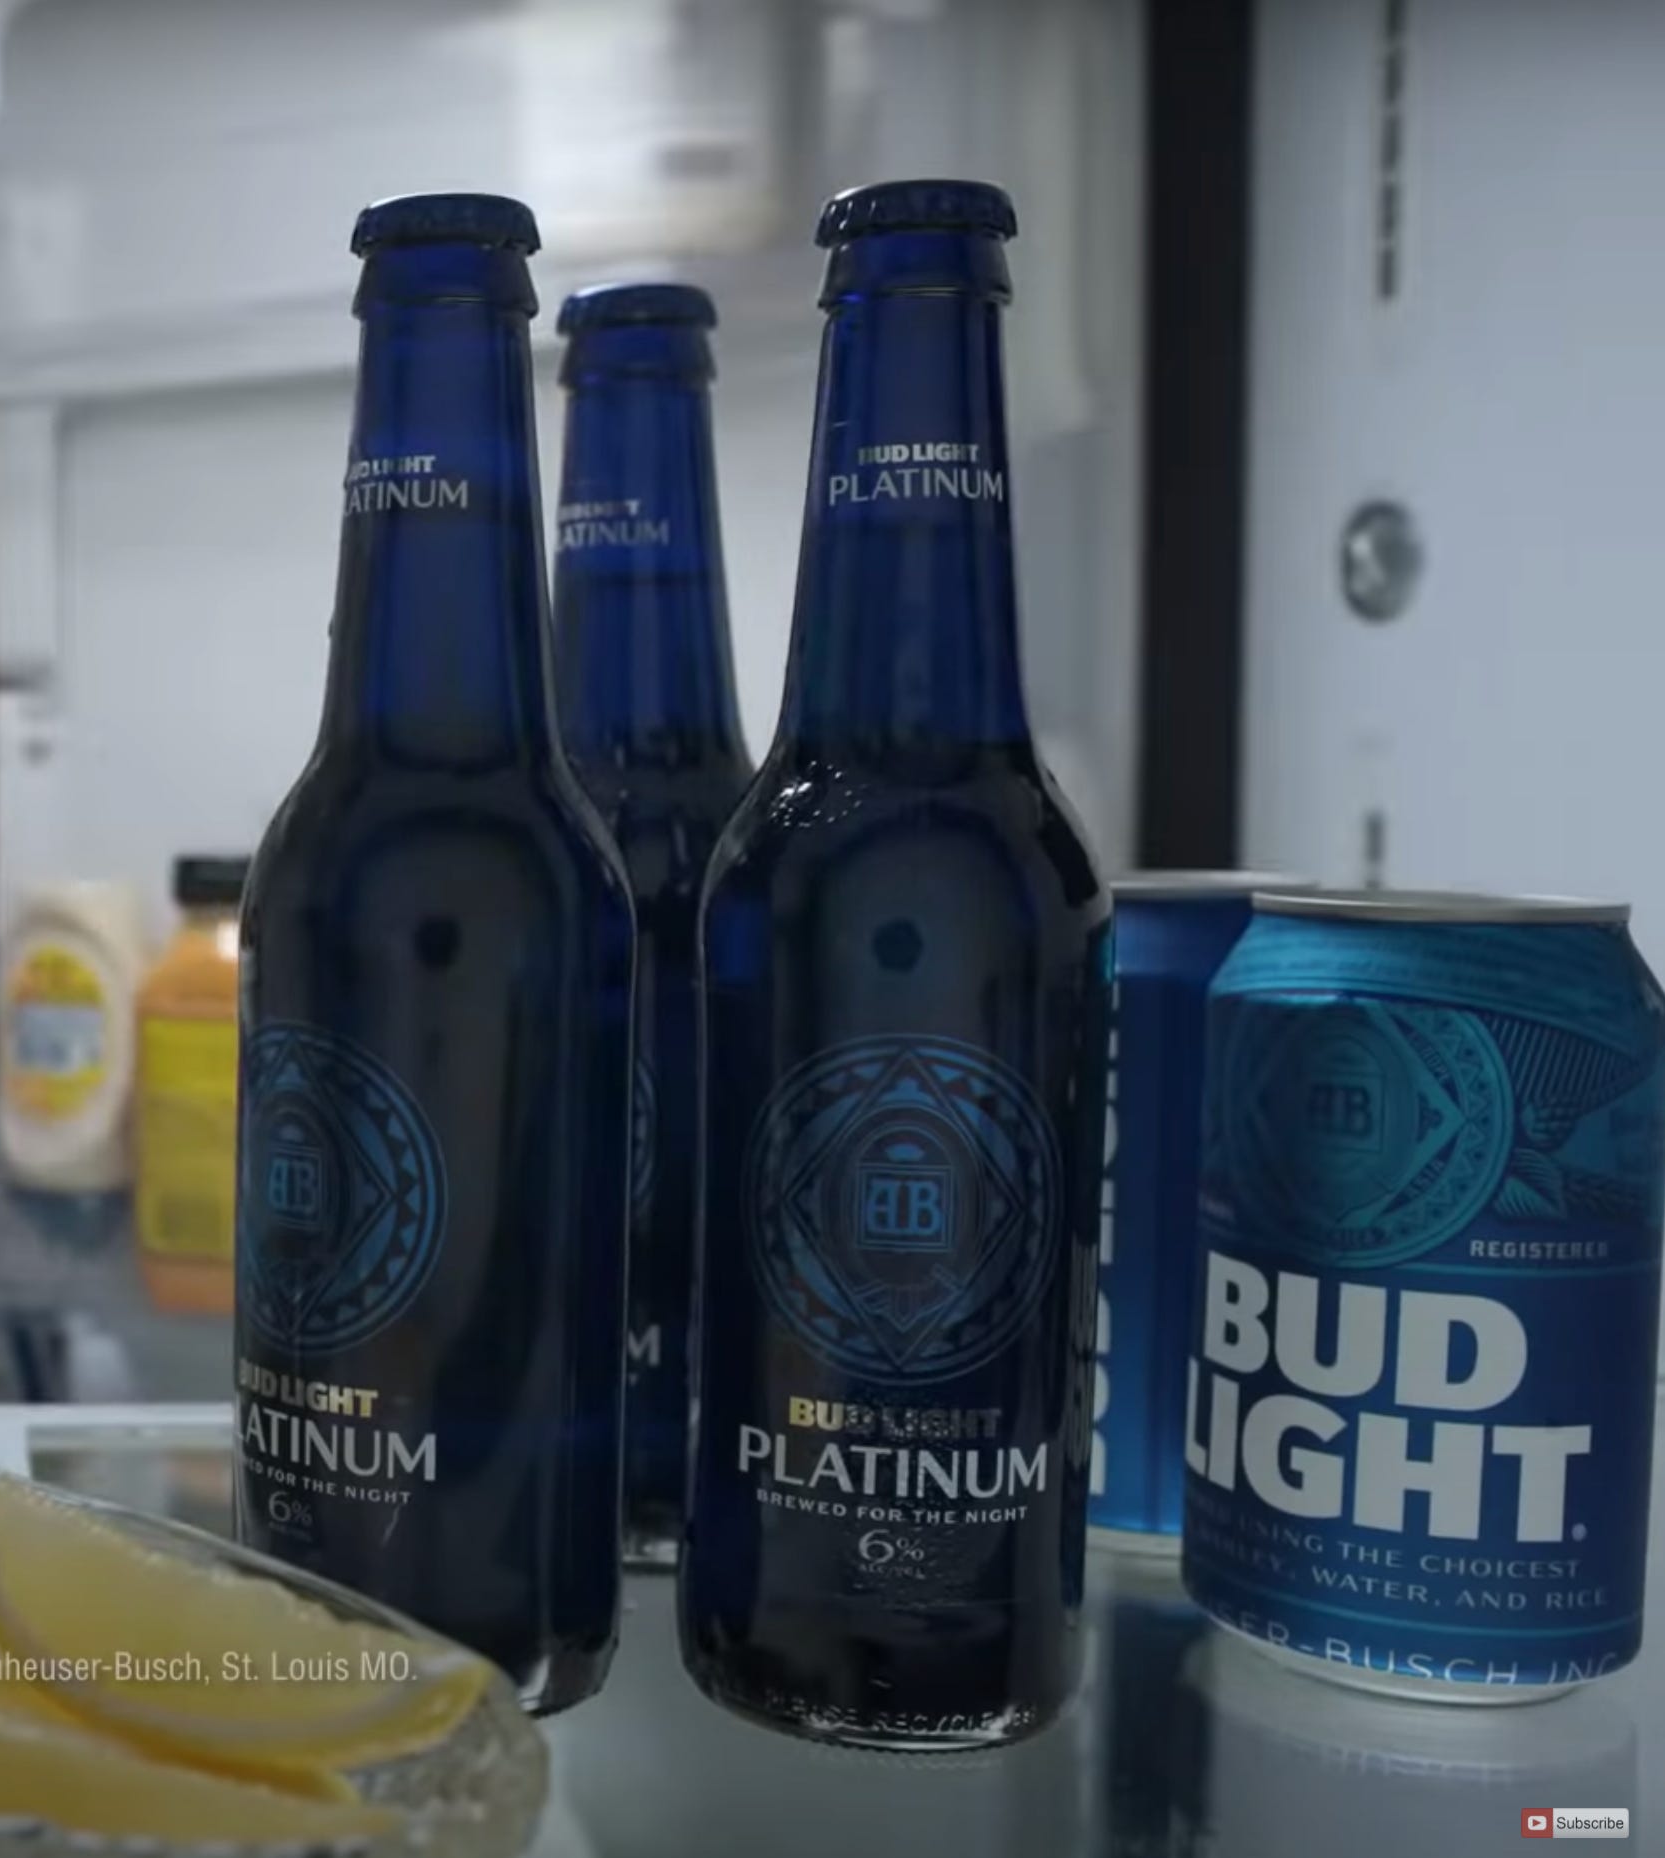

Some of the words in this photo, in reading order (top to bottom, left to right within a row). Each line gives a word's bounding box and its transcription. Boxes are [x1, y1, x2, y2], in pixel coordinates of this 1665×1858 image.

[858, 444, 910, 465] BUD
[912, 442, 980, 463] LIGHT
[343, 478, 469, 516] ATINUM
[829, 466, 1004, 507] PLATINUM
[556, 517, 670, 553] ATINUM
[1203, 1249, 1528, 1412] BUD
[280, 1374, 379, 1418] LIGHT
[788, 1396, 877, 1435] BUD
[882, 1407, 1002, 1439] LIGHT
[237, 1402, 437, 1481] ATINUM
[738, 1423, 1049, 1500] PLATINUM
[1184, 1357, 1593, 1543] LIGHT
[267, 1465, 296, 1487] FOR
[302, 1477, 338, 1496] THE
[345, 1485, 411, 1504] NIGHT
[756, 1488, 848, 1518] BREWED
[856, 1506, 903, 1522] FOR
[913, 1508, 956, 1525] THE
[965, 1505, 1029, 1524] NIGHT
[858, 1528, 926, 1565] 6%
[1337, 1541, 1405, 1570] THE
[1420, 1554, 1582, 1580] CHOICEST
[1311, 1565, 1441, 1606] WATER,
[1455, 1588, 1527, 1612] AND
[1545, 1587, 1608, 1610] RICE
